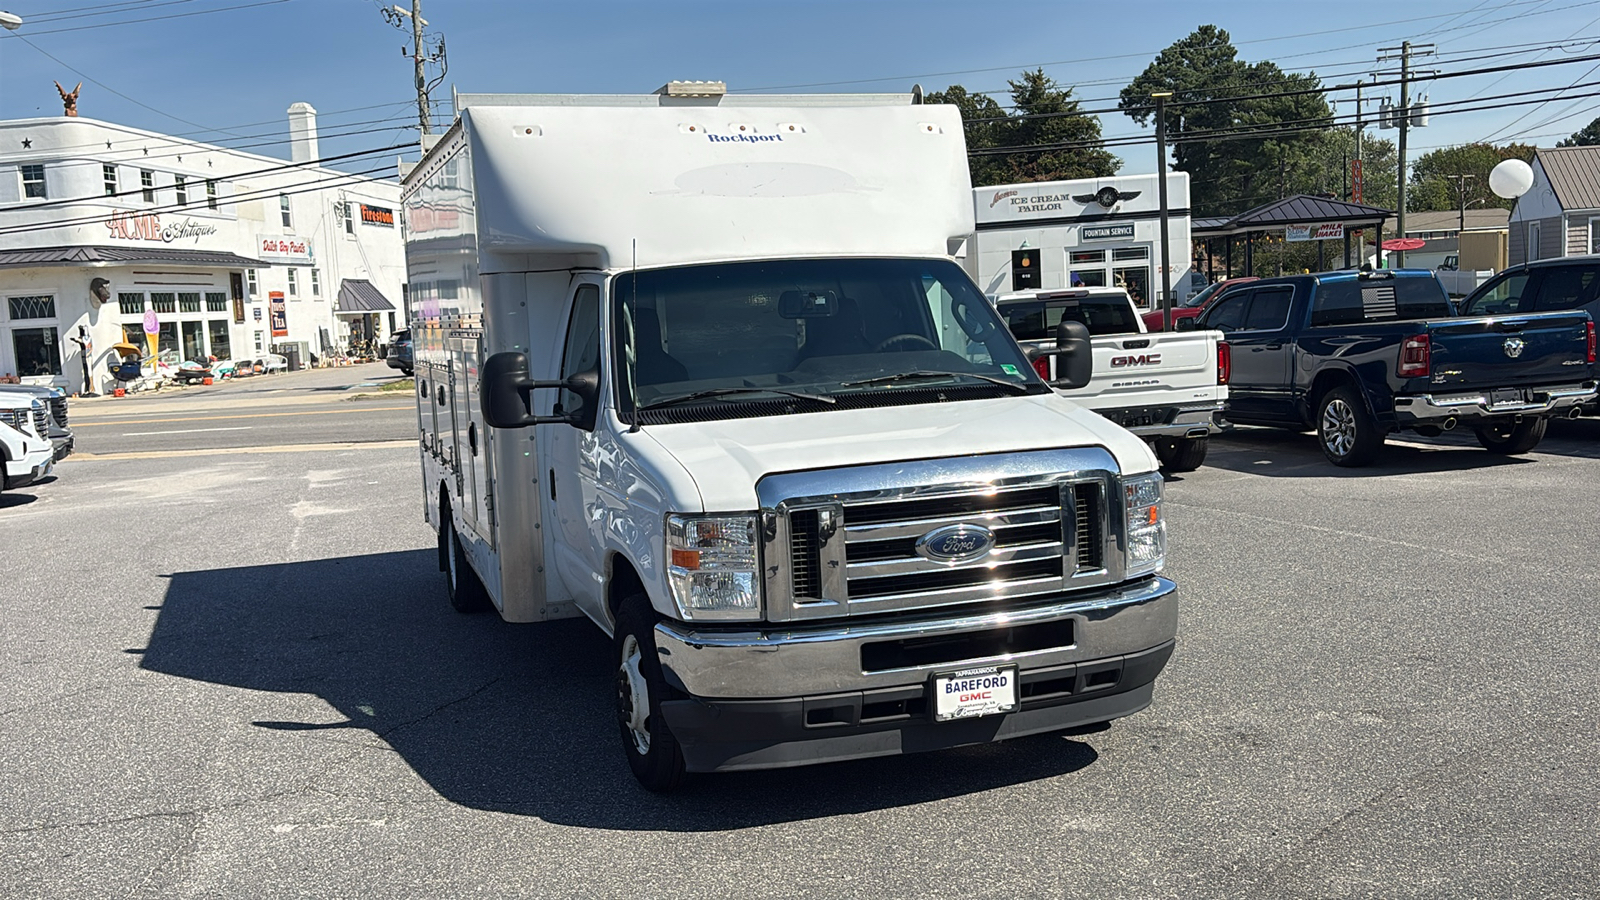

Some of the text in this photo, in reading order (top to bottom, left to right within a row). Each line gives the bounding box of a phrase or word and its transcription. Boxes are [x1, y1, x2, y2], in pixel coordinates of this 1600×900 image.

[707, 134, 784, 143] Rockport
[1010, 194, 1070, 205] ICE CREAM
[1018, 203, 1062, 213] PARLOR
[105, 209, 217, 244] ACME Antiques
[1084, 226, 1133, 238] FOUNTAIN SERVICE
[1320, 223, 1343, 231] MILK
[1110, 353, 1162, 369] GMC
[942, 534, 977, 553] Ford
[945, 676, 1008, 695] BAREFORD
[959, 691, 992, 703] GMC
